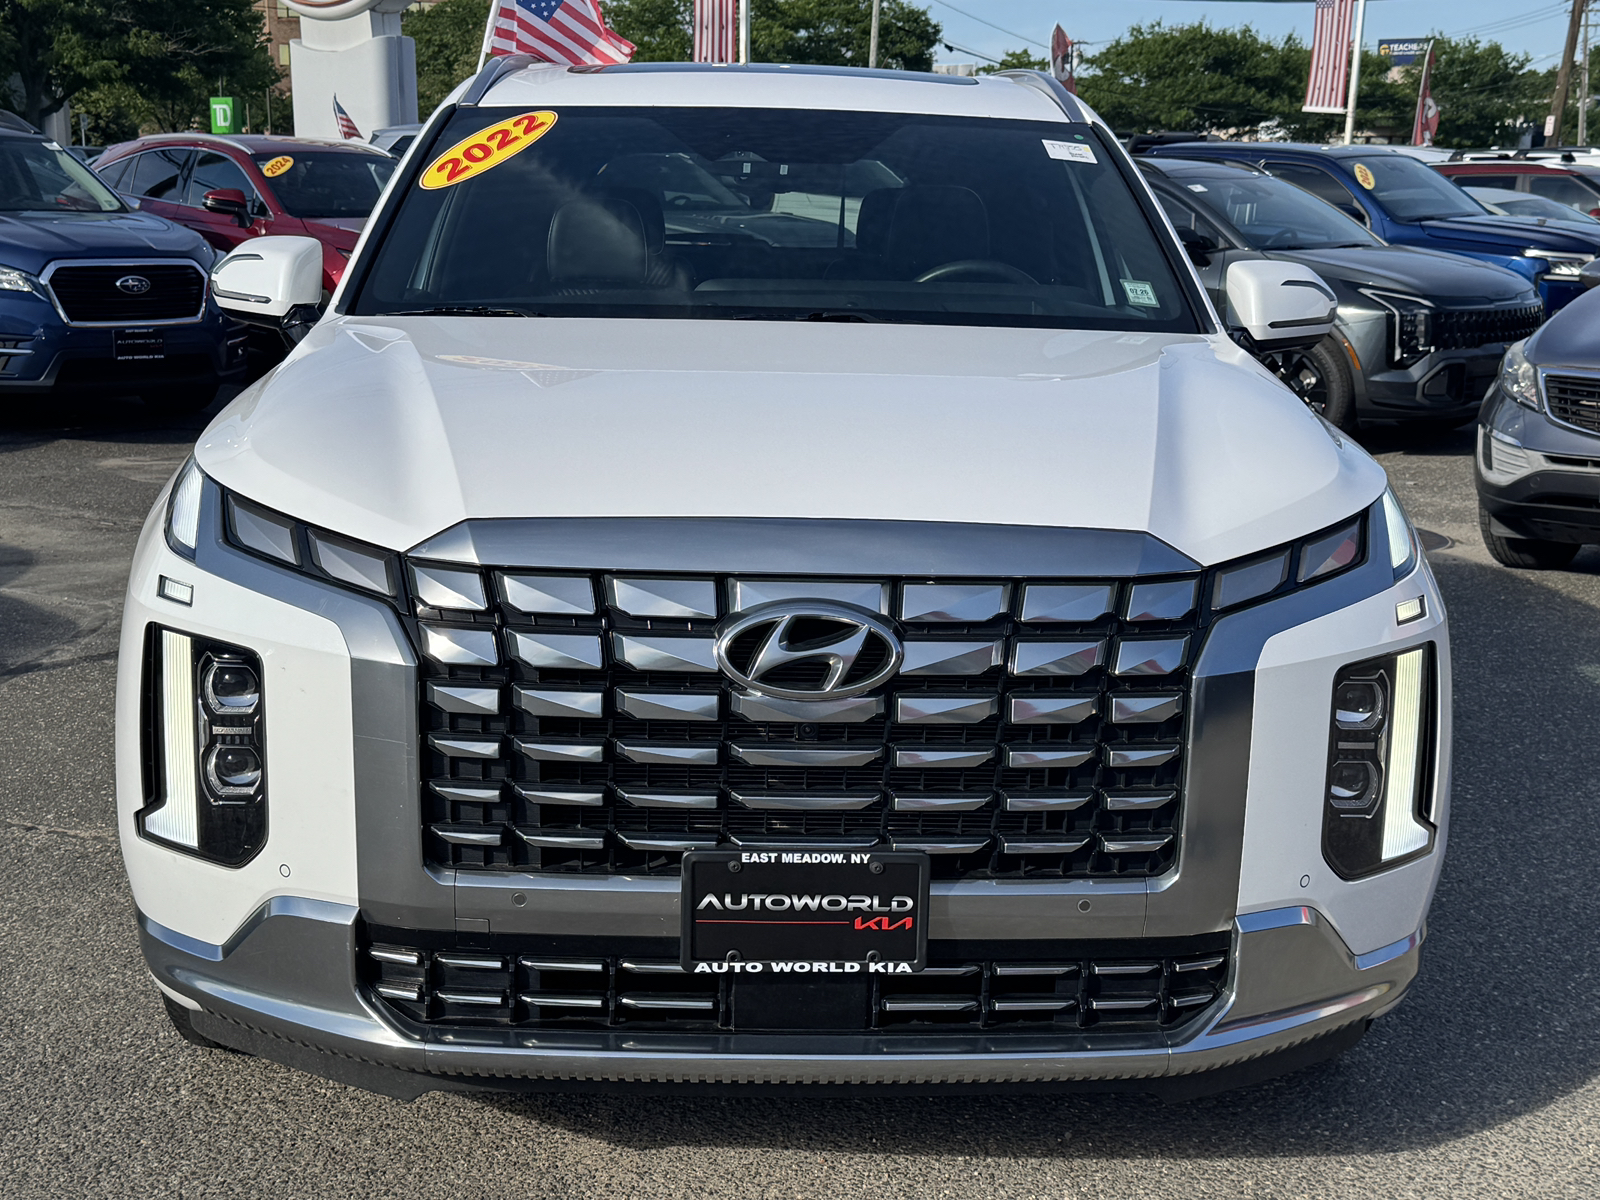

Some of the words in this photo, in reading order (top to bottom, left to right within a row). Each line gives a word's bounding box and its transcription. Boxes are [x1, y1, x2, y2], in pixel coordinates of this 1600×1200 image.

[212, 104, 231, 127] TD
[436, 115, 549, 183] 2022
[266, 156, 291, 175] 2024
[741, 852, 778, 863] EAST
[850, 853, 871, 864] NY
[695, 892, 914, 913] AUTOWORLD
[694, 962, 763, 973] AUTO
[771, 962, 861, 973] WORLD
[868, 962, 913, 973] KIA
